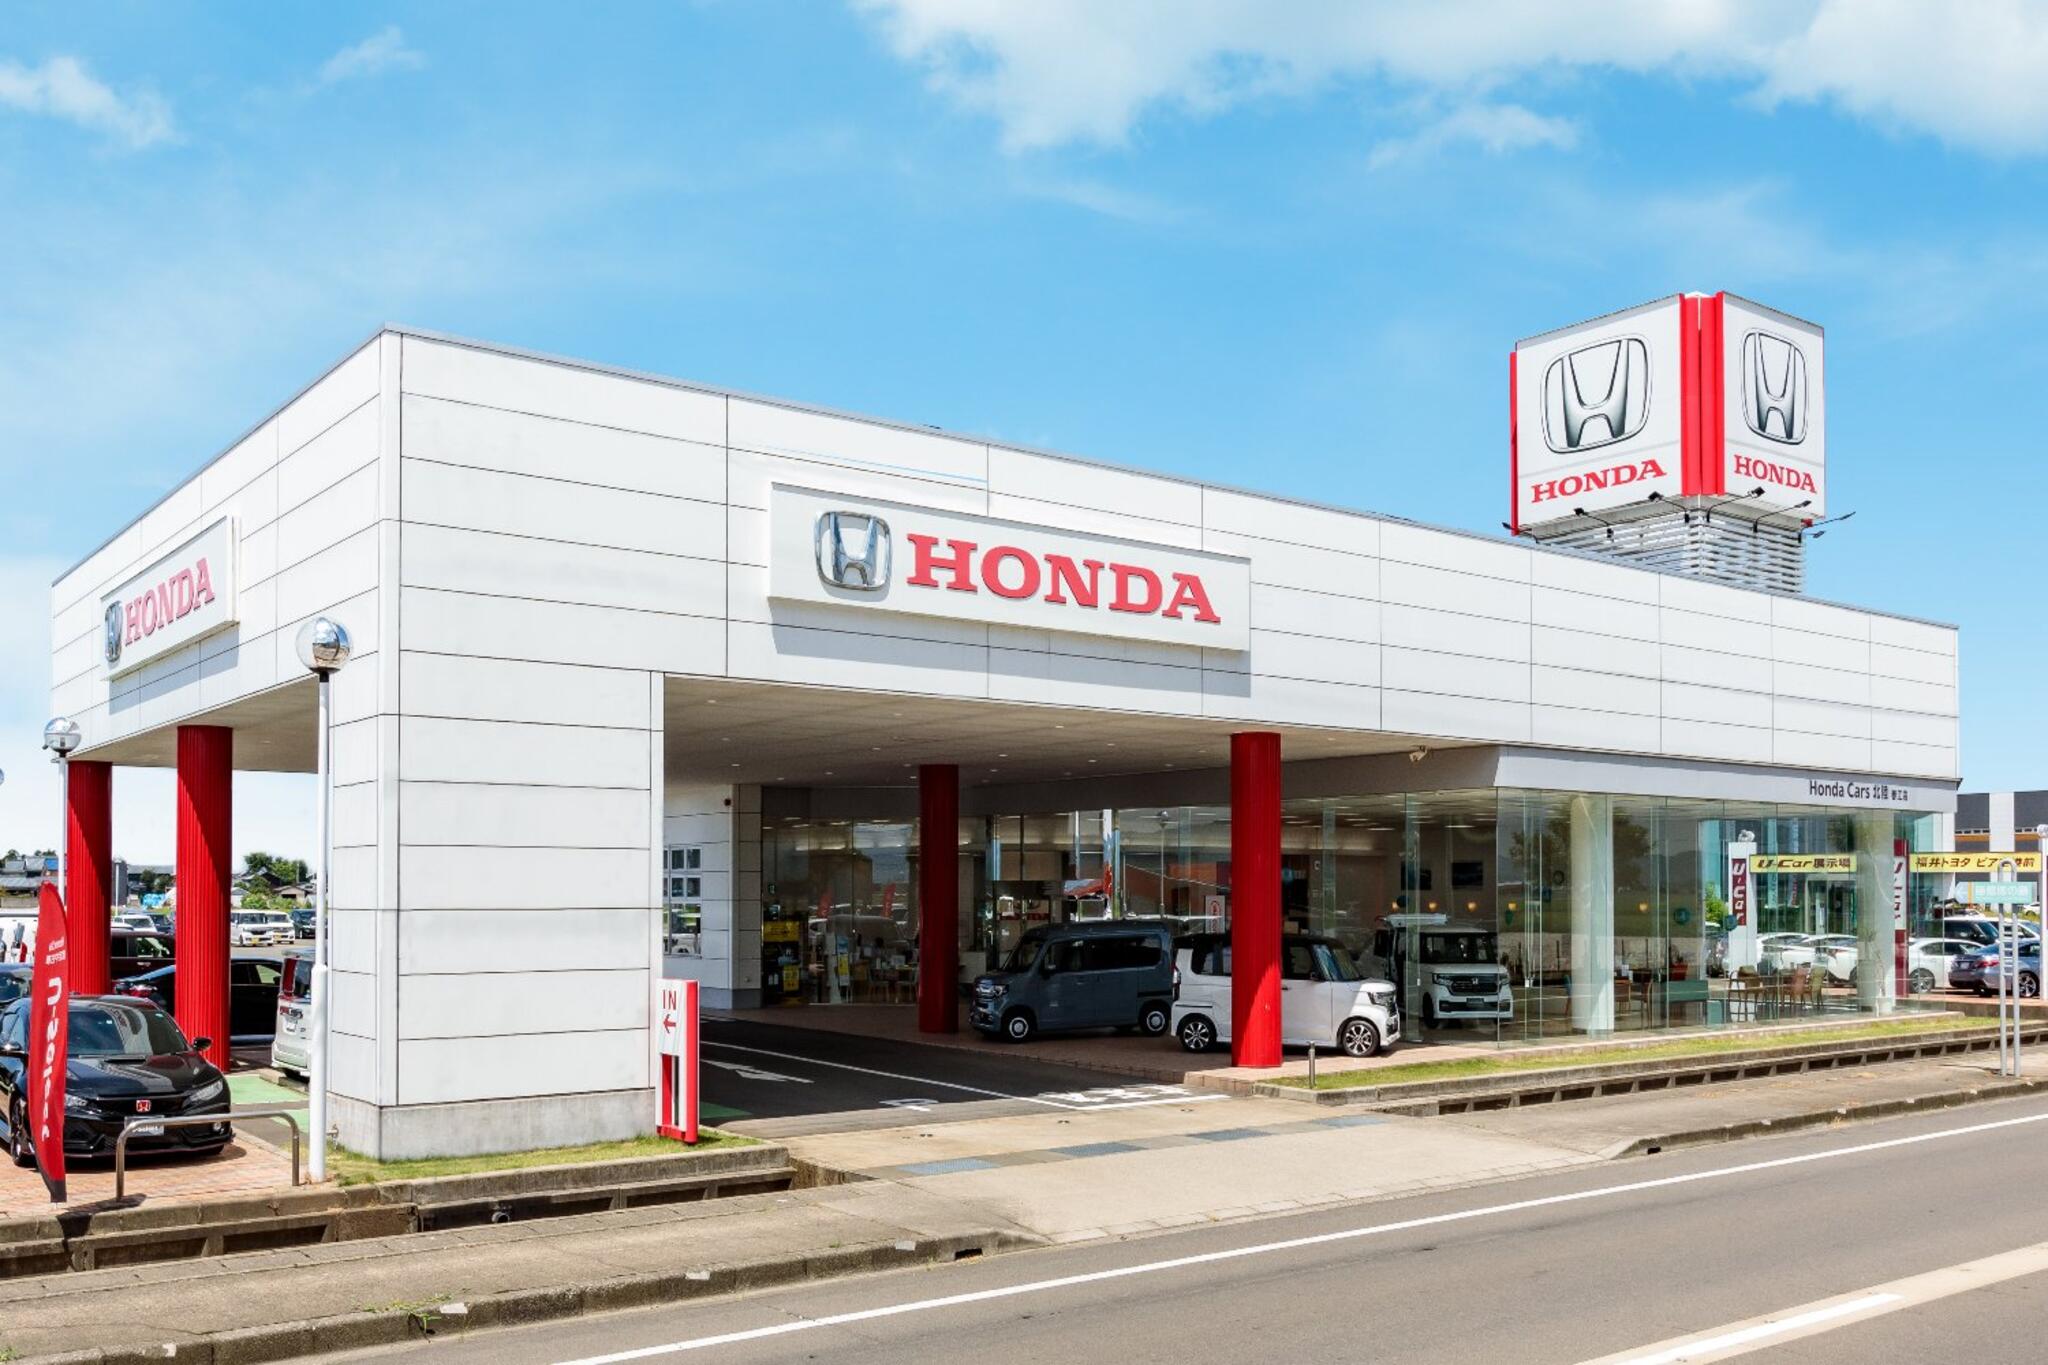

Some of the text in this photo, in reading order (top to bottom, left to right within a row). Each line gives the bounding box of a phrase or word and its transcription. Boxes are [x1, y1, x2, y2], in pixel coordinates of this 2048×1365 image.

[1531, 459, 1667, 503] HONDA
[1733, 454, 1817, 494] HONDA
[906, 533, 1221, 624] HONDA
[125, 557, 215, 647] HONDA
[1809, 780, 1844, 797] Honda
[1847, 782, 1871, 799] Cars
[1915, 856, 1971, 868] 福井トヨタ
[662, 989, 677, 1010] IN
